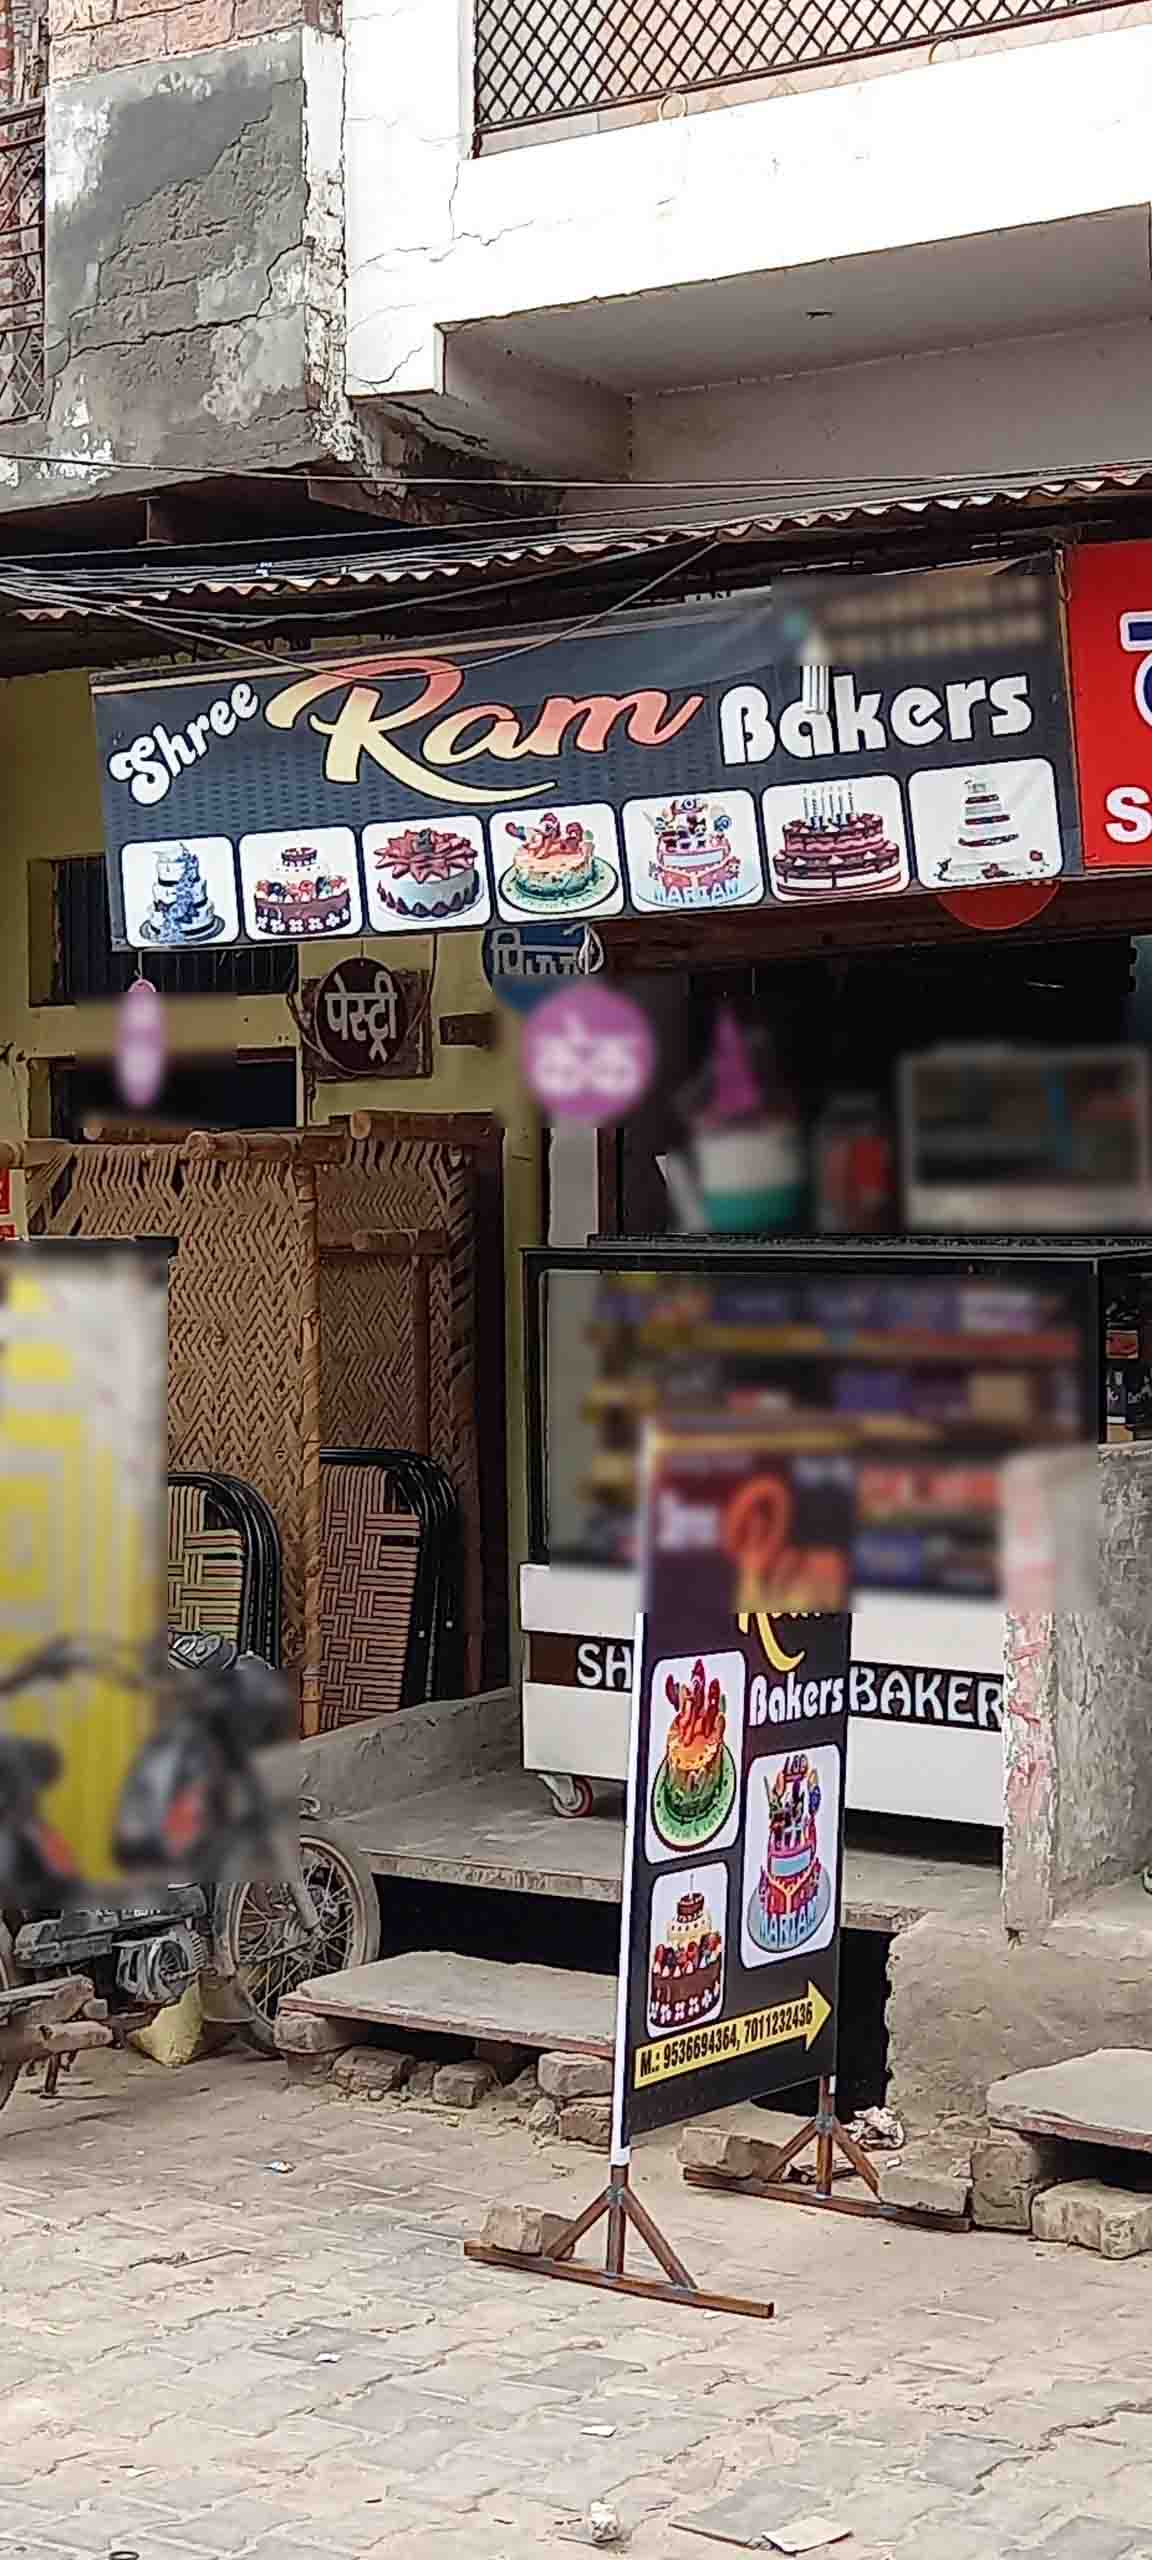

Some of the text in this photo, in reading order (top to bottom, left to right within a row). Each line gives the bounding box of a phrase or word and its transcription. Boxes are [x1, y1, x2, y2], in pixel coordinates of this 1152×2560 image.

[108, 656, 1034, 806] Shree Ram Bakers
[323, 970, 398, 1062] पेस्ट्री
[749, 1671, 845, 1726] Bakers
[663, 2023, 741, 2069] 9536694364,
[744, 2001, 813, 2043] 7011232436
